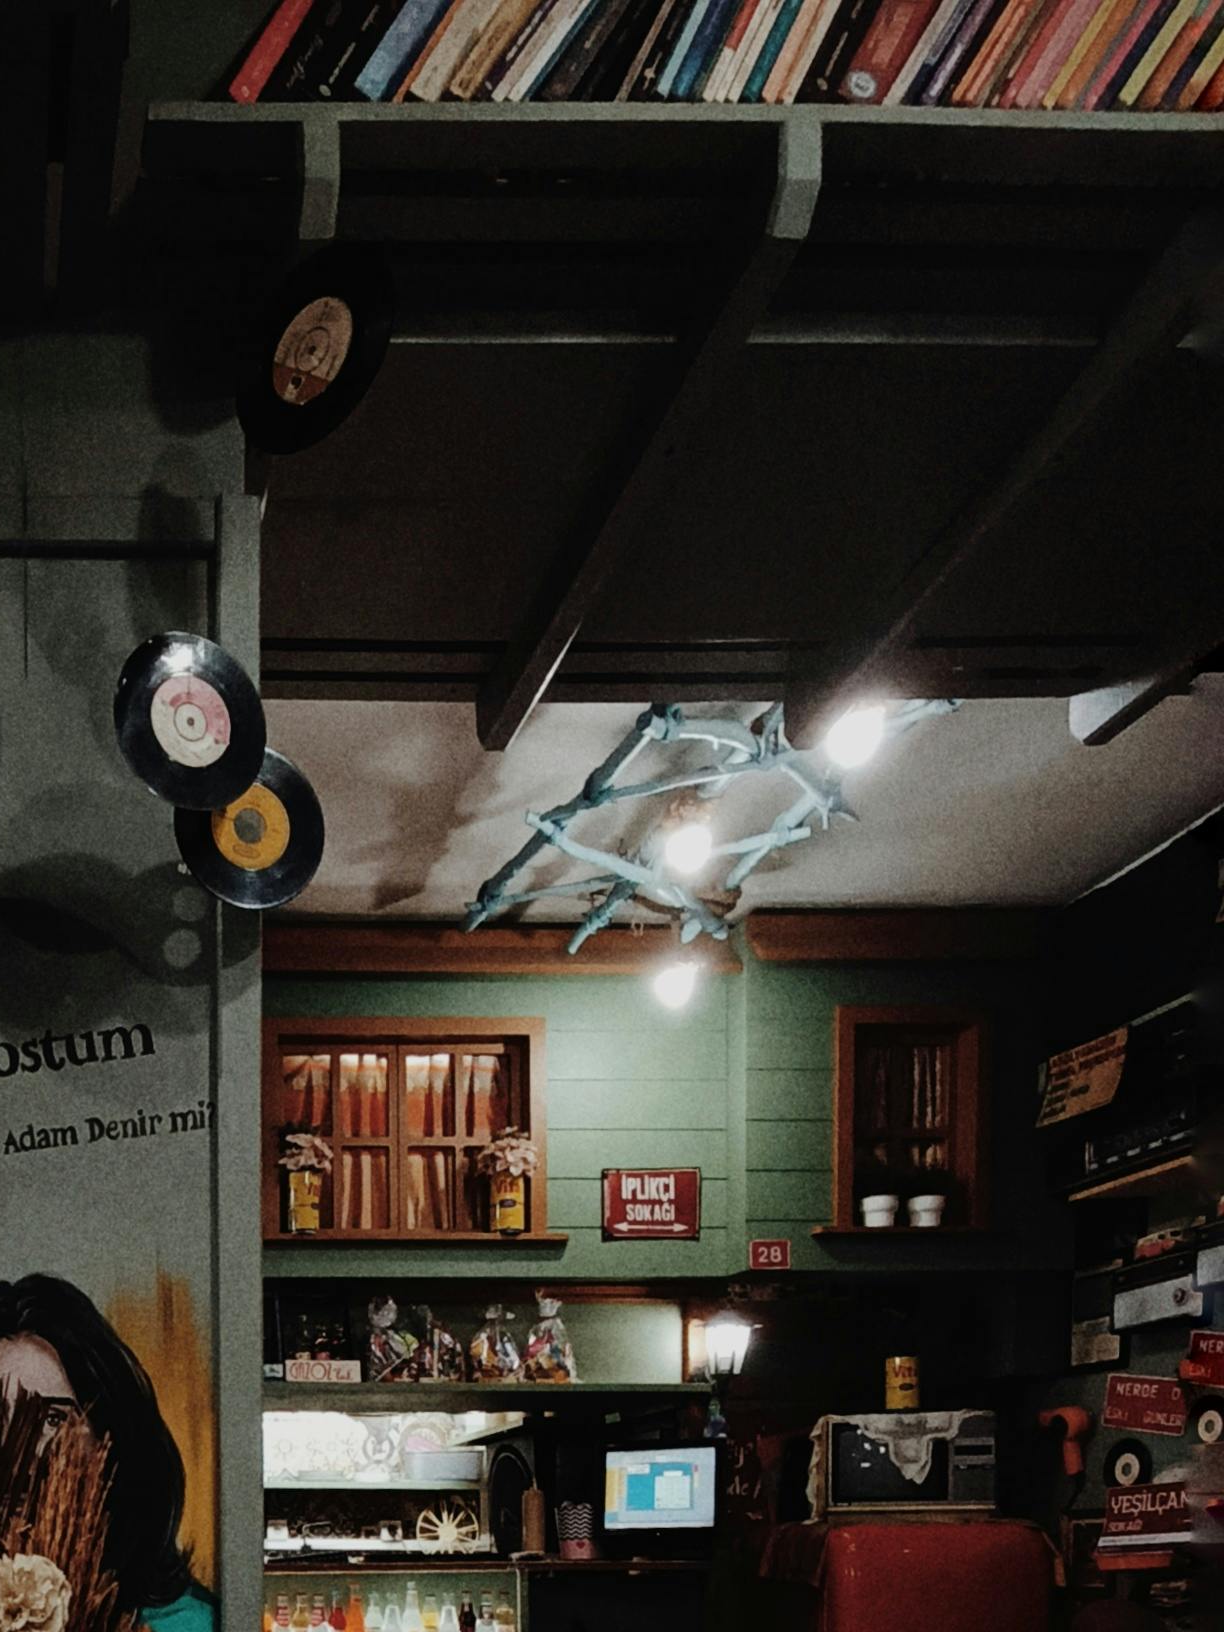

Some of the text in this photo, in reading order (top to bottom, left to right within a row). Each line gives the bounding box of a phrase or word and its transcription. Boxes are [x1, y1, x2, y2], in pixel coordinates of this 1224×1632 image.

[2, 1125, 79, 1156] Adam
[84, 1112, 163, 1144] Denir
[168, 1100, 216, 1136] mi?
[621, 1173, 675, 1202] İPLİKÇİ
[625, 1202, 675, 1221] SOKAĞI
[757, 1246, 780, 1264] 28
[1116, 1383, 1158, 1398] NERDE
